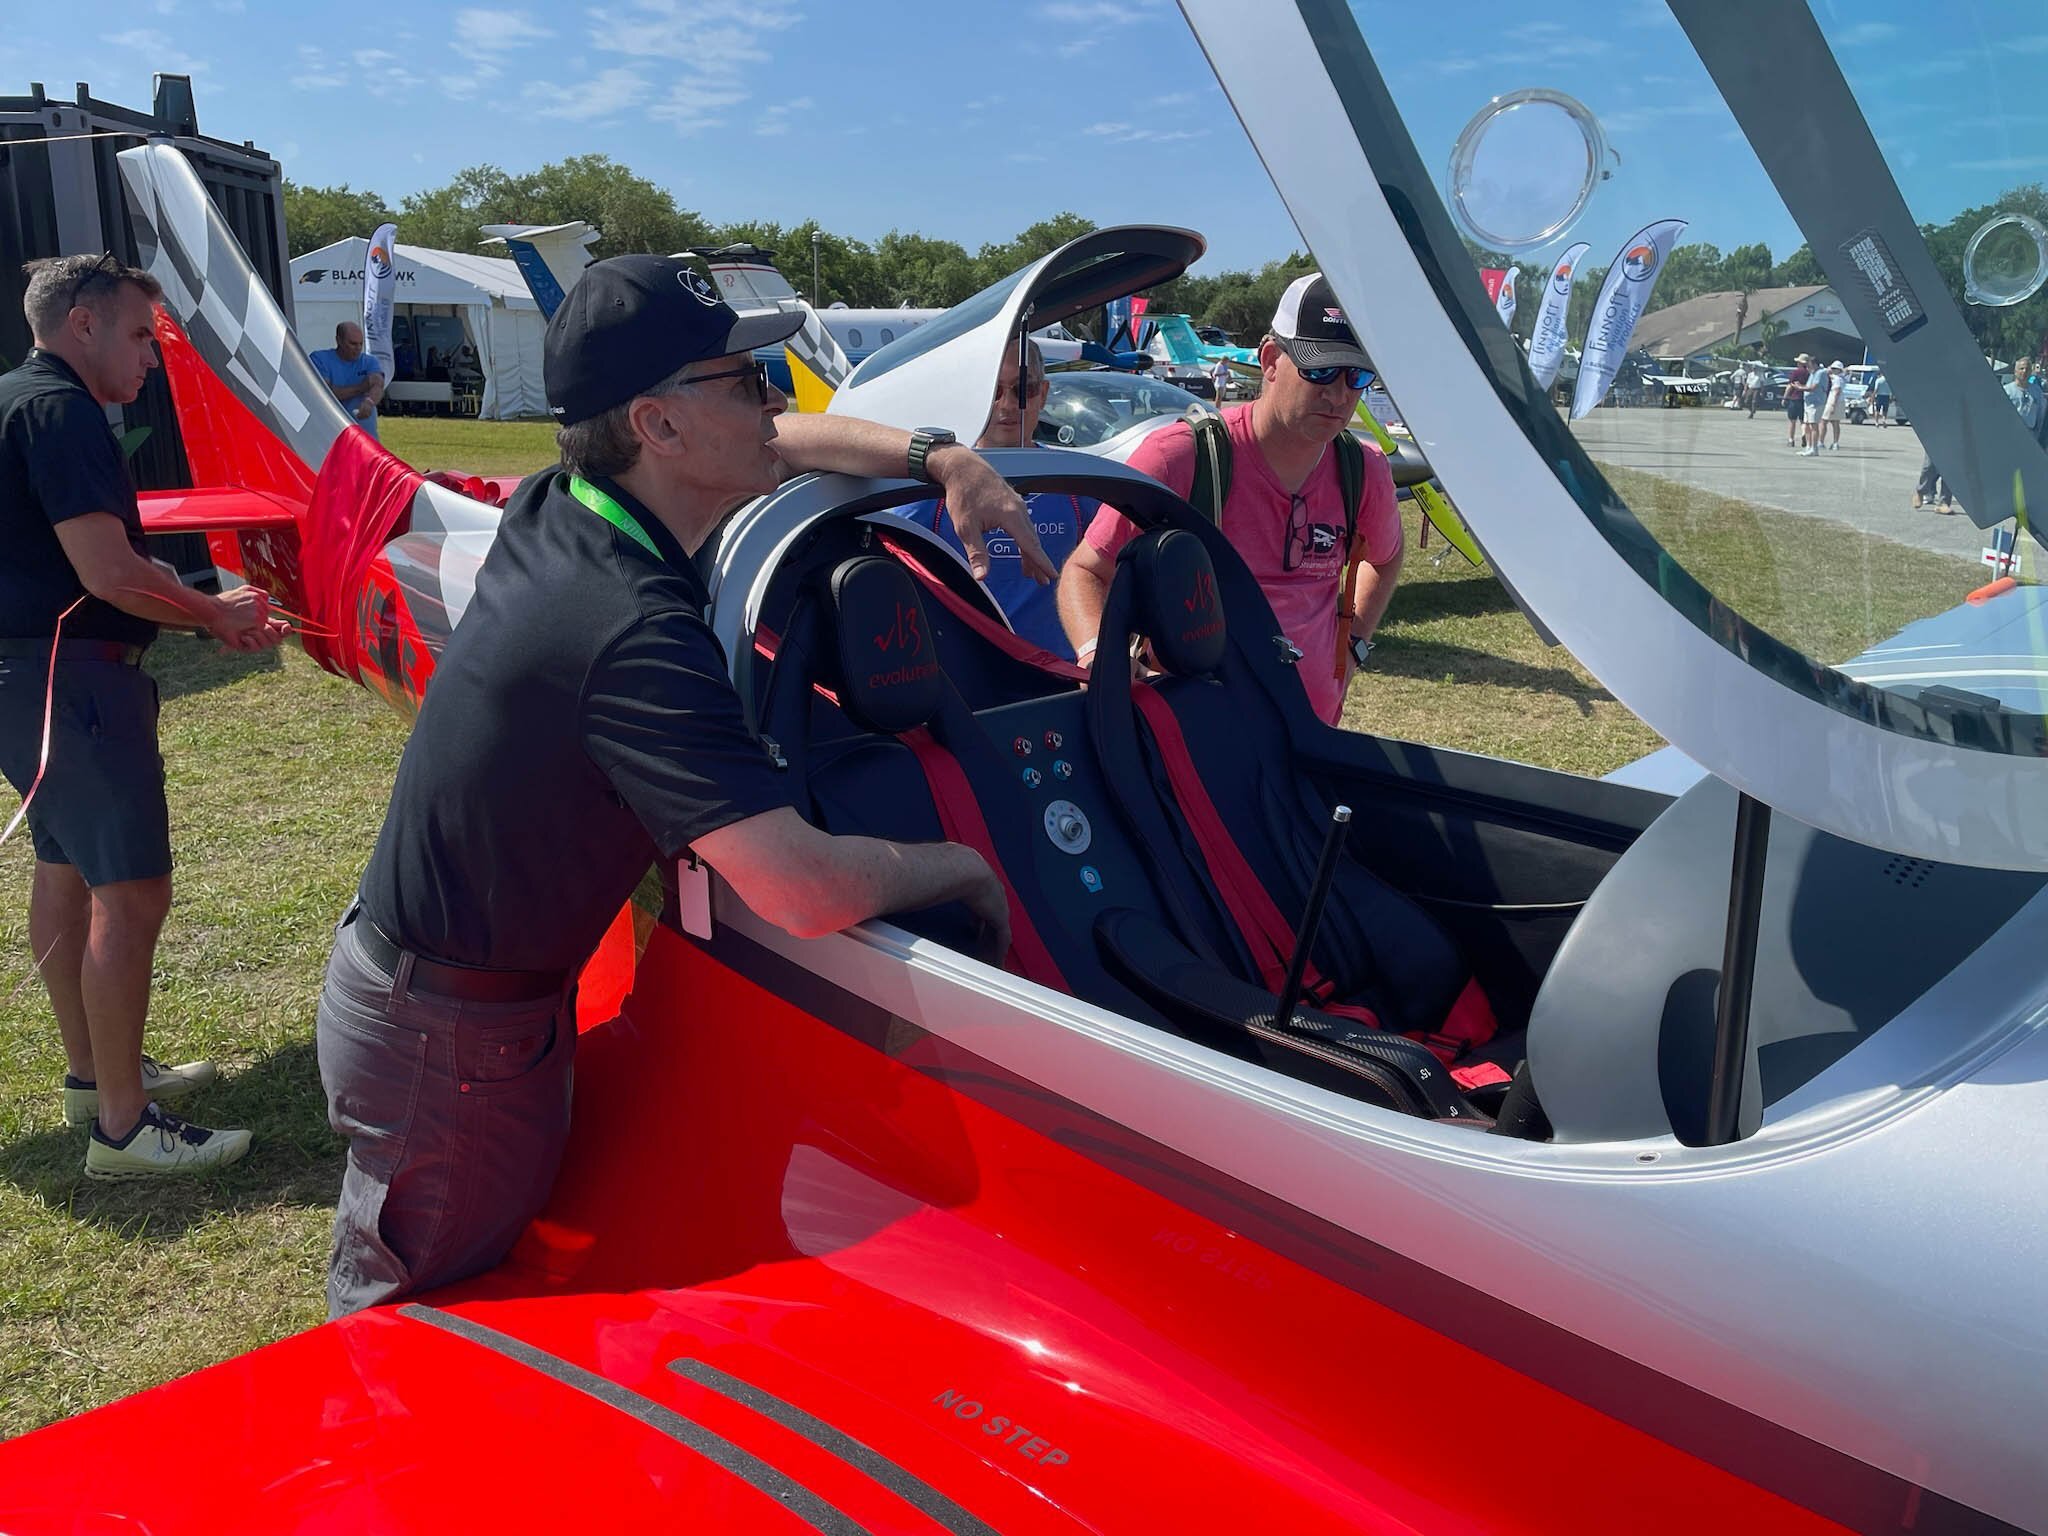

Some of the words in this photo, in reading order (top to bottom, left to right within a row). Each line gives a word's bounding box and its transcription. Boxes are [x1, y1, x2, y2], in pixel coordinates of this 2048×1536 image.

[332, 270, 416, 282] BLACWK
[1034, 522, 1065, 535] ODE
[993, 543, 1011, 554] On
[932, 1388, 984, 1420] NO
[981, 1415, 1070, 1466] STEP
